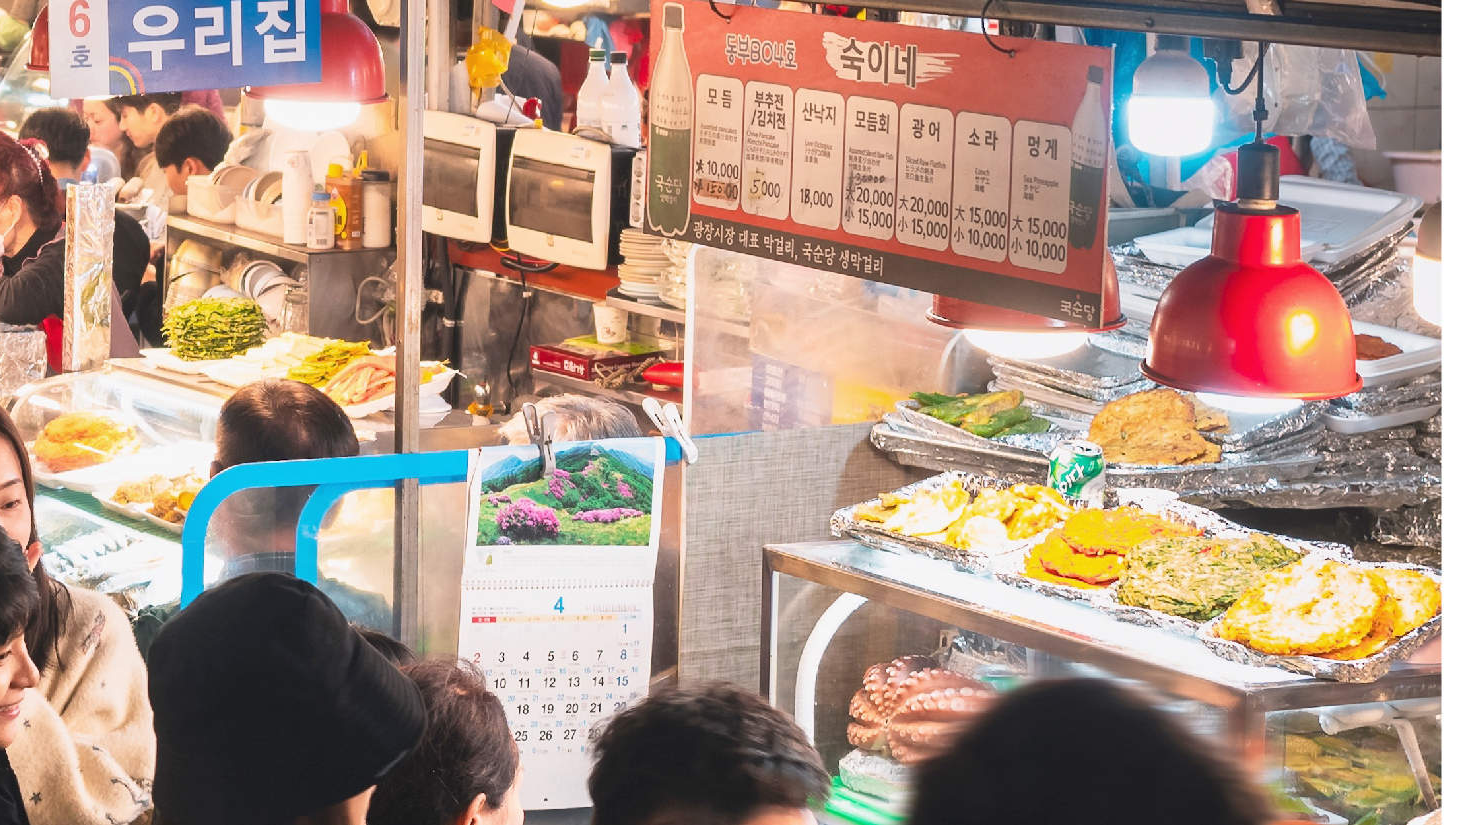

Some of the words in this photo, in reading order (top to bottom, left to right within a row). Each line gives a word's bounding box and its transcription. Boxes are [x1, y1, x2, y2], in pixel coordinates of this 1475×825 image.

[68, 0, 91, 38] 6
[128, 0, 306, 71] 우리집
[70, 44, 92, 69] 호
[840, 38, 917, 88] 숙이네
[754, 90, 784, 111] 부추전
[751, 109, 786, 130] /김치전
[802, 101, 837, 126] 산낙지
[854, 110, 890, 134] 모듬회
[707, 160, 739, 180] 10,000
[856, 186, 894, 208] 20,000
[898, 195, 908, 211] 大
[910, 196, 949, 218] 20,000
[858, 208, 893, 229] 15,000
[898, 216, 908, 232] 小
[911, 218, 948, 239] 15,000
[954, 205, 965, 221] 大
[969, 206, 1007, 229] 15,000
[1012, 215, 1023, 233] 大
[1027, 217, 1067, 240] 15,000
[693, 220, 736, 246] 광장시장
[738, 229, 759, 249] 대표
[764, 234, 798, 262] 막걸리,
[802, 242, 836, 267] 국순당
[839, 249, 884, 277] 생막걸리
[954, 226, 965, 243] 小
[967, 228, 1006, 250] 10,000
[1011, 237, 1022, 254] 小
[1026, 239, 1066, 262] 10,000
[1060, 300, 1096, 322] 국순당
[553, 596, 565, 614] 4
[474, 652, 481, 664] 2
[498, 652, 505, 662] 3
[522, 651, 530, 662] 4
[548, 651, 555, 662] 5
[572, 651, 579, 661] 6
[597, 650, 604, 661] 7
[620, 650, 627, 660] 8
[494, 678, 506, 689] 10
[518, 678, 530, 688] 11
[544, 678, 556, 688] 12
[568, 677, 580, 688] 13
[592, 677, 604, 687] 14
[616, 676, 628, 686] 15
[516, 704, 530, 714] 18
[542, 704, 554, 714] 19
[566, 704, 579, 714] 20
[590, 702, 602, 713] 21
[515, 731, 528, 742] 25
[539, 730, 552, 741] 26
[564, 730, 576, 740] 27
